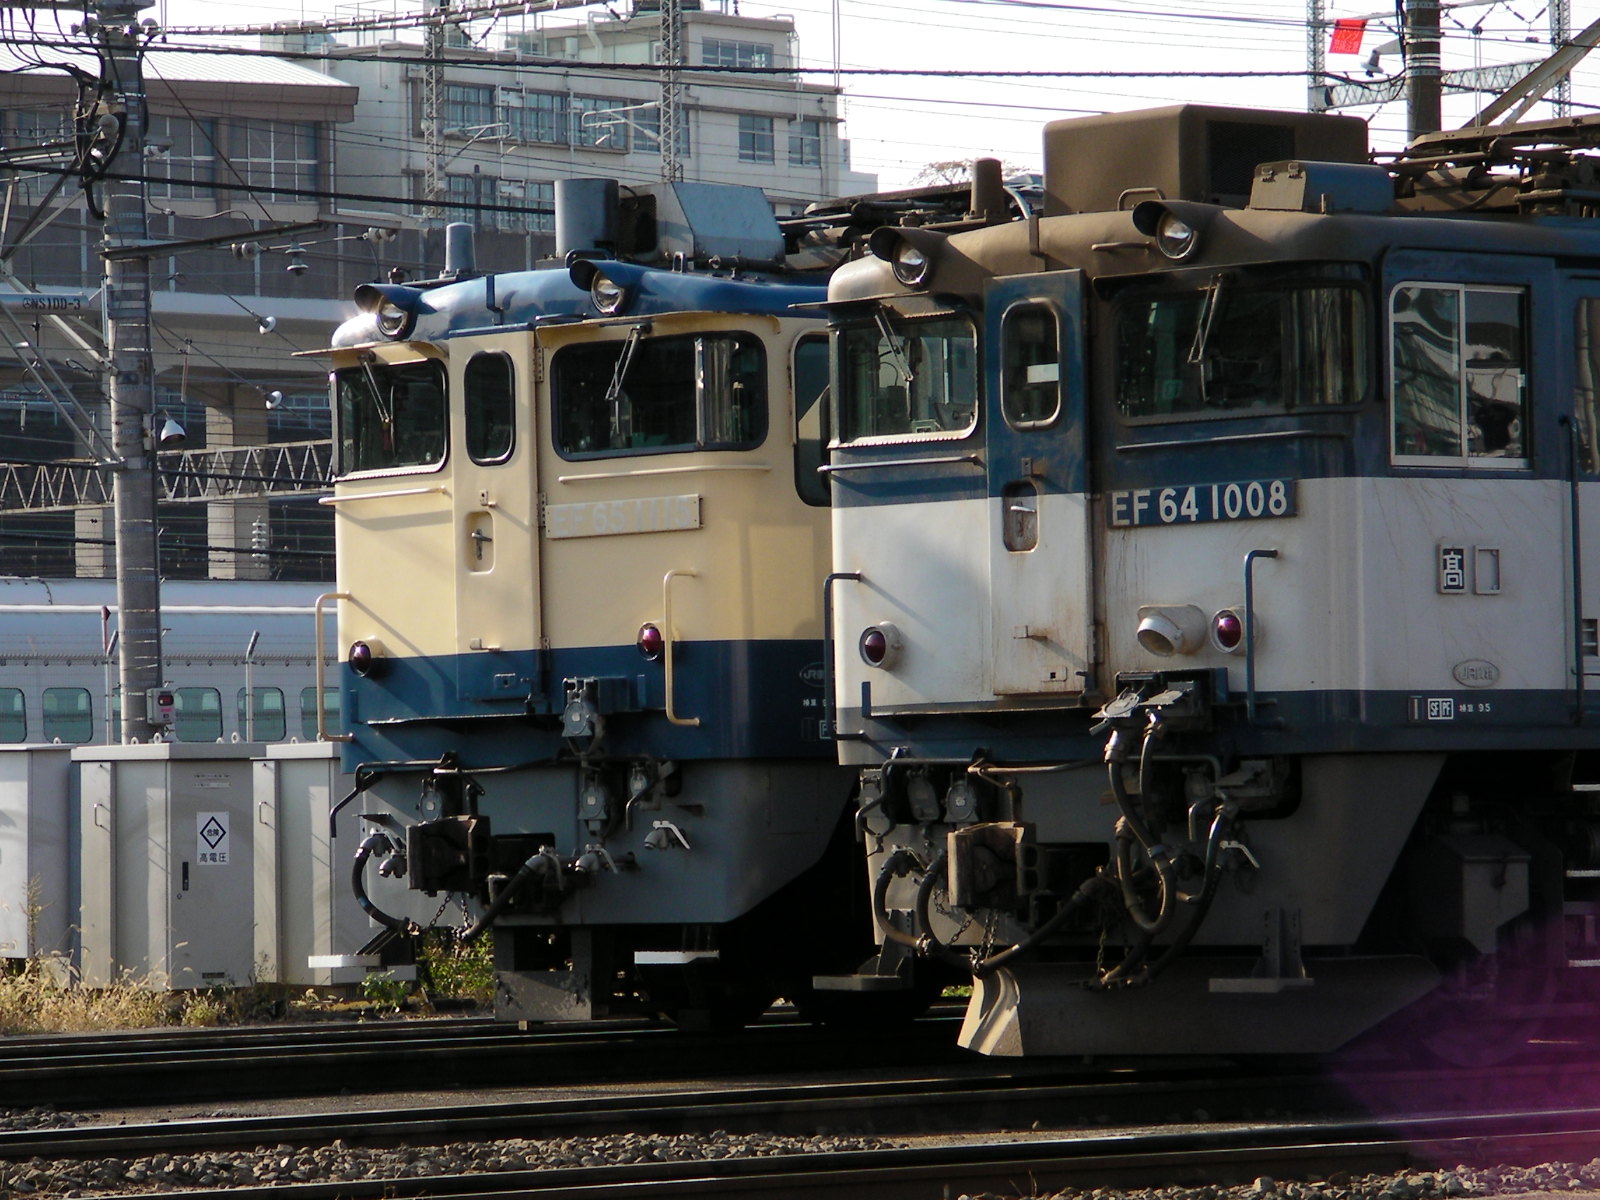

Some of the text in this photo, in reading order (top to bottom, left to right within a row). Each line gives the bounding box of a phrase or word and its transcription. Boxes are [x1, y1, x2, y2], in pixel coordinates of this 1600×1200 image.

[555, 503, 588, 537] EF
[592, 499, 626, 533] 65
[1112, 479, 1288, 526] EF 64 1008
[199, 852, 227, 863] 高電圧
